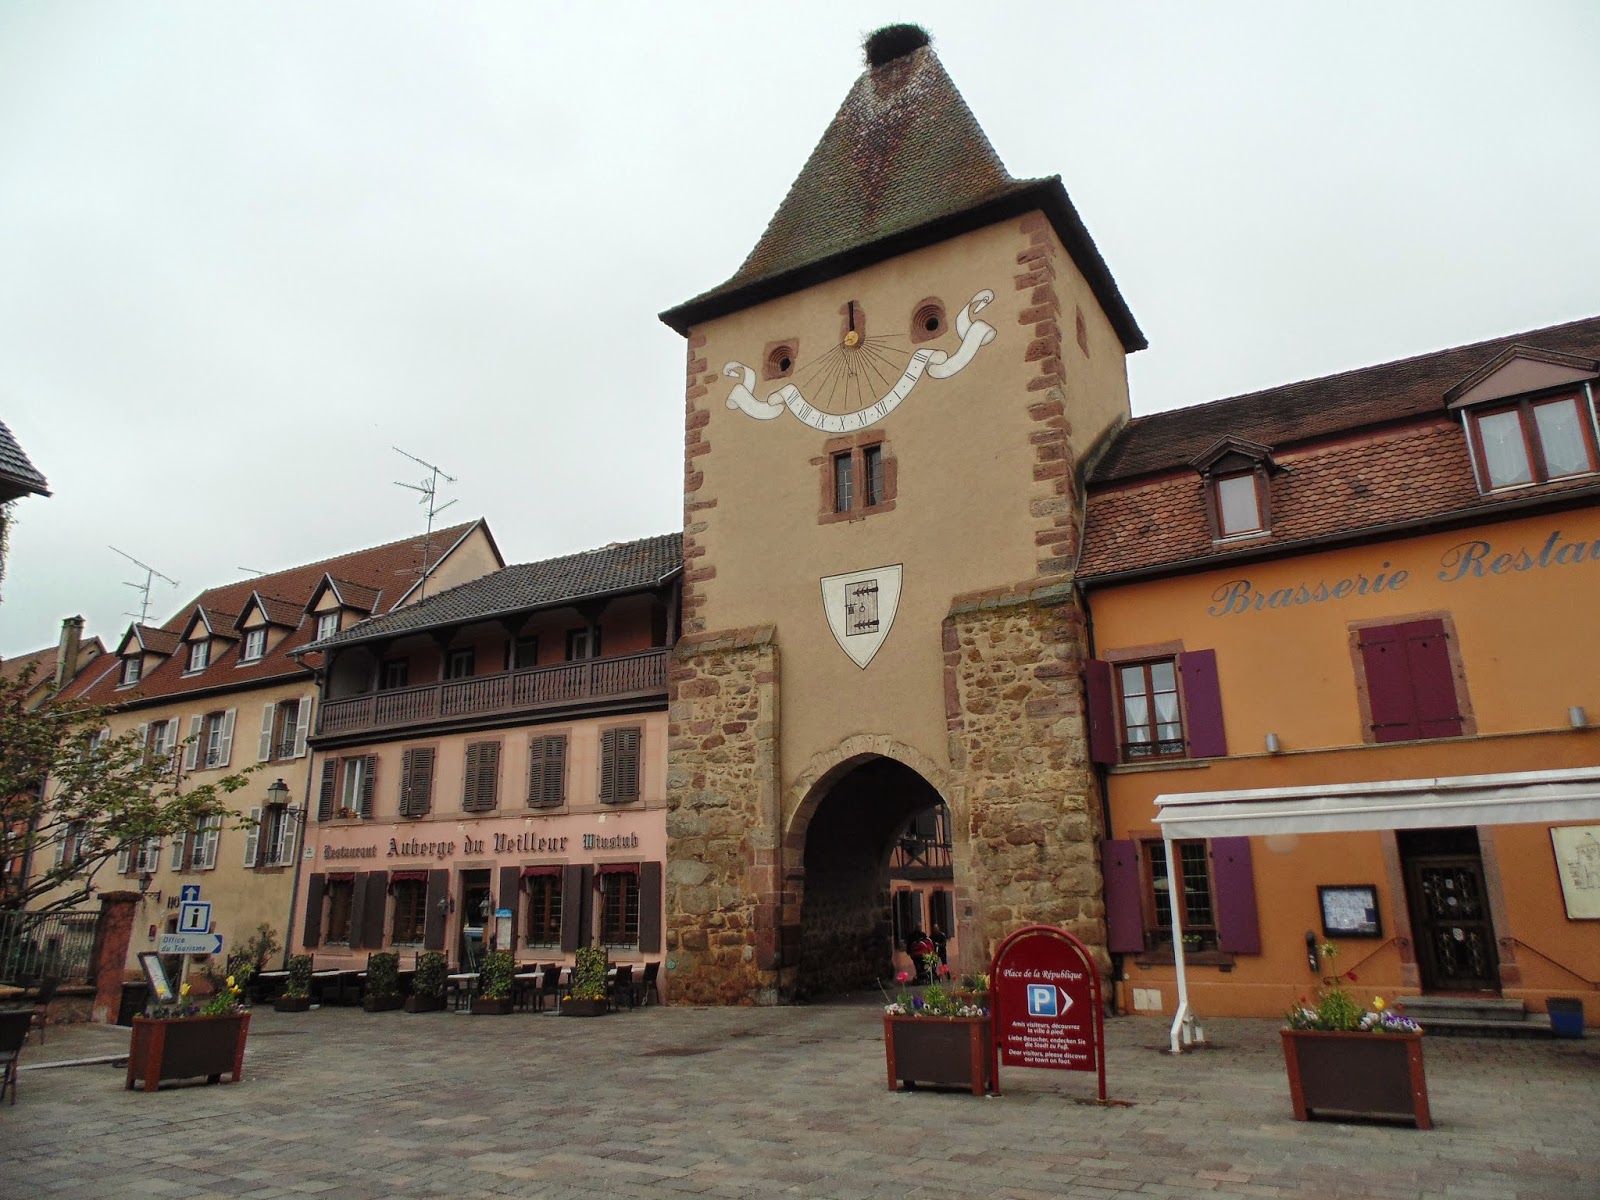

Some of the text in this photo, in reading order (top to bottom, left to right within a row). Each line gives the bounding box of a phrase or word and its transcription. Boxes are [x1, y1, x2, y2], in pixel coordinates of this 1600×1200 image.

[1208, 562, 1409, 616] Brasserie
[323, 844, 378, 860] Restaurant
[386, 837, 456, 861] Auberge
[464, 834, 484, 854] du
[493, 832, 569, 853] Veilleur
[582, 831, 639, 850] Winstub
[1003, 968, 1082, 981] Place de la République
[1034, 988, 1050, 1012] P
[1051, 1022, 1080, 1030] découvrez
[1063, 1052, 1088, 1060] discover
